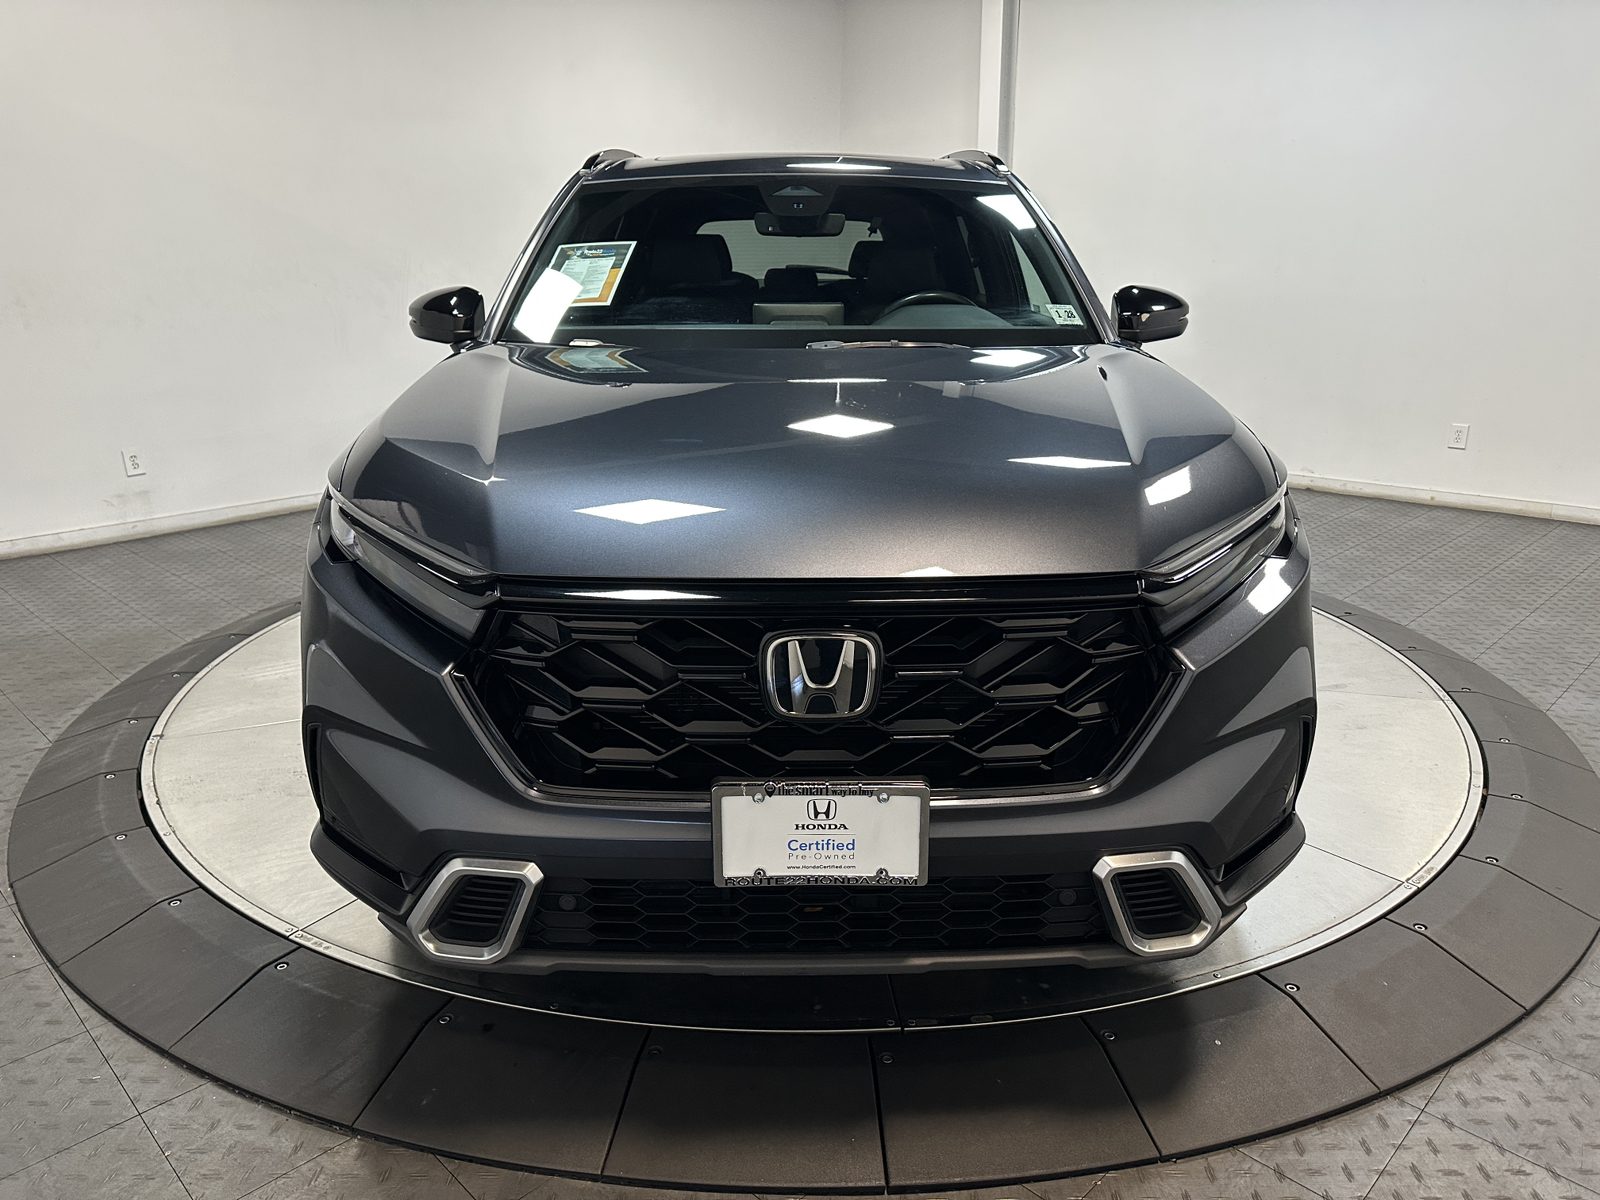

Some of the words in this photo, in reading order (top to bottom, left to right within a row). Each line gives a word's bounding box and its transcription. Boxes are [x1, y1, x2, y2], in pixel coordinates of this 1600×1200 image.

[1055, 310, 1062, 318] 1
[1064, 310, 1076, 318] 28
[795, 781, 829, 796] smart
[831, 788, 848, 798] way
[787, 838, 856, 851] Certified
[788, 852, 855, 860] Pre-Owned
[724, 876, 918, 886] ROUTE22HONDA.COM
